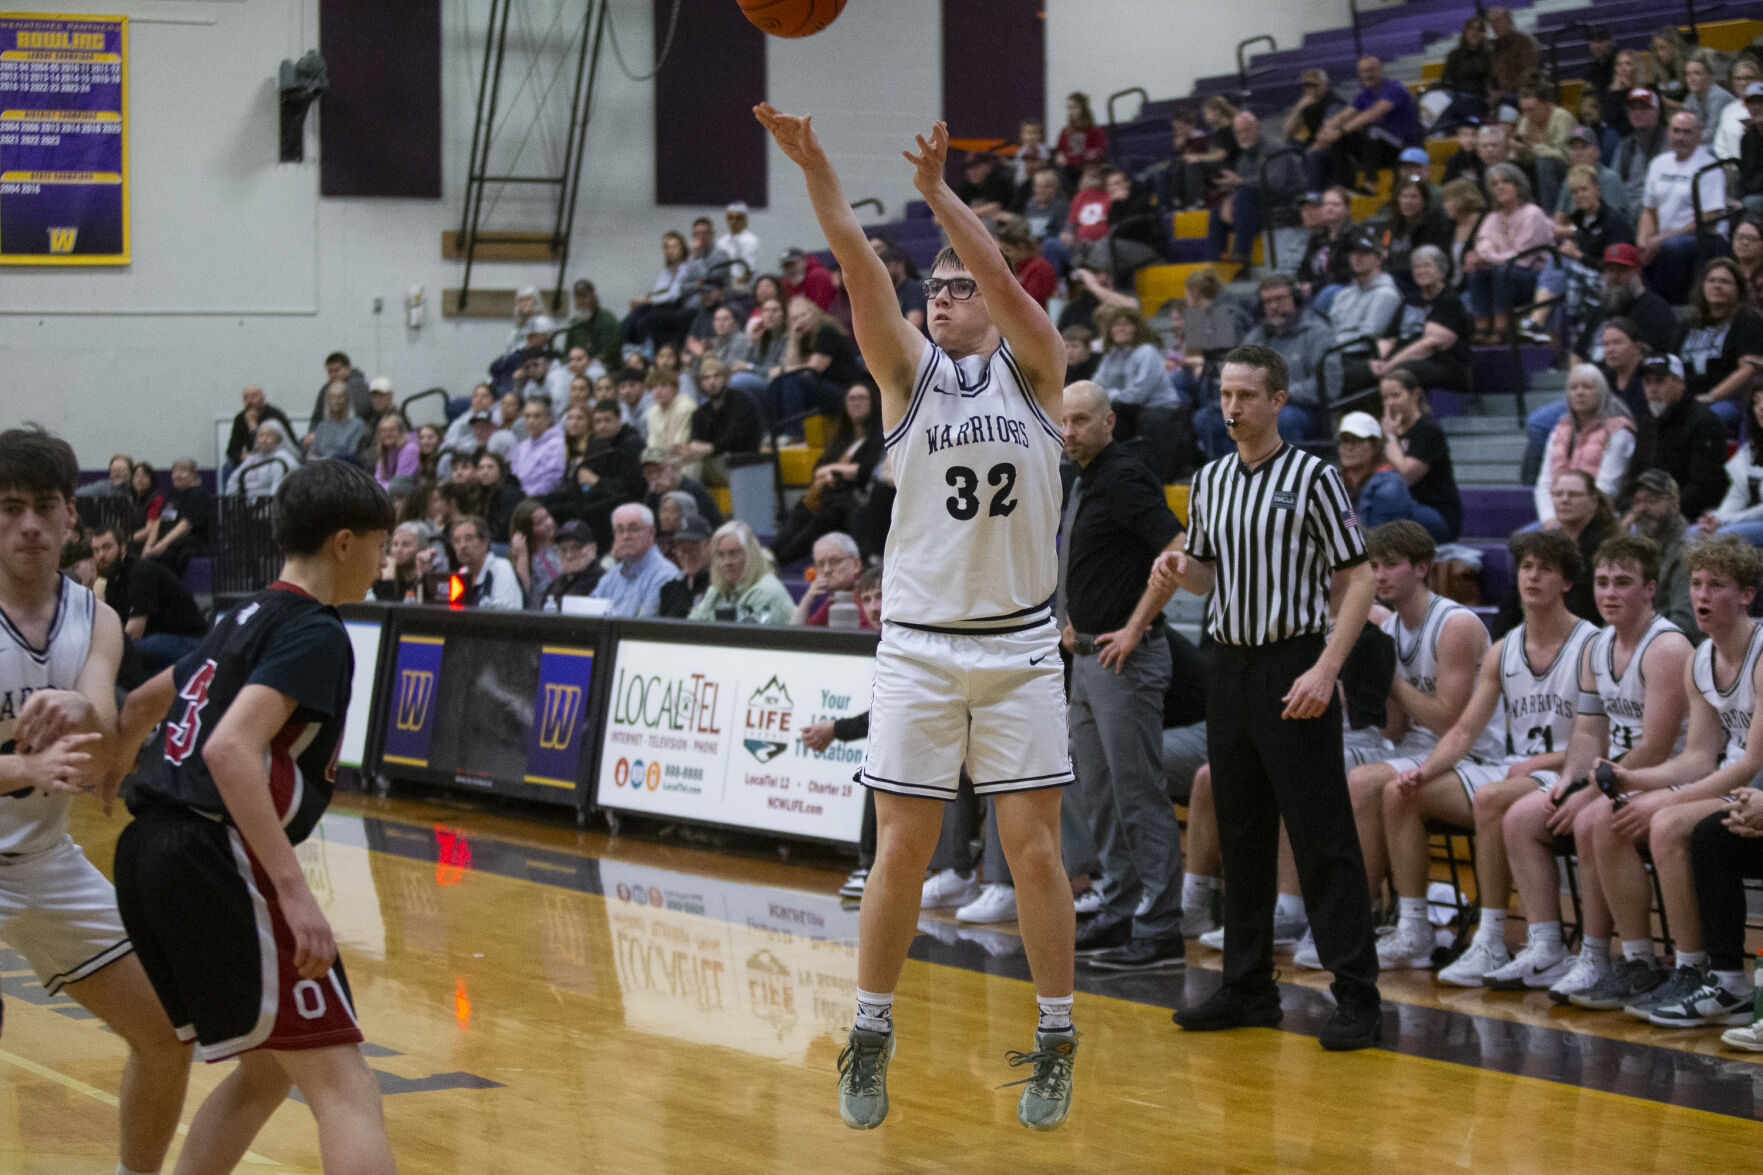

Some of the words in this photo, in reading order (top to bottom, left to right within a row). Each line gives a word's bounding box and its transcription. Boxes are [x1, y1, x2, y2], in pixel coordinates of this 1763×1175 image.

[16, 30, 105, 50] BOWLING
[47, 227, 78, 254] W
[926, 415, 1030, 455] WARRIORS
[945, 462, 1018, 521] 32
[397, 669, 433, 731] W
[614, 667, 720, 735] LOCALTEL
[821, 689, 852, 710] Your
[1511, 694, 1574, 719] WARRIRS
[539, 683, 581, 750] W
[745, 709, 793, 732] LIFE
[693, 740, 719, 755] PHONE
[745, 773, 778, 788] LocalTel
[808, 780, 840, 796] Charter
[767, 796, 823, 816] NCWLIFE.com
